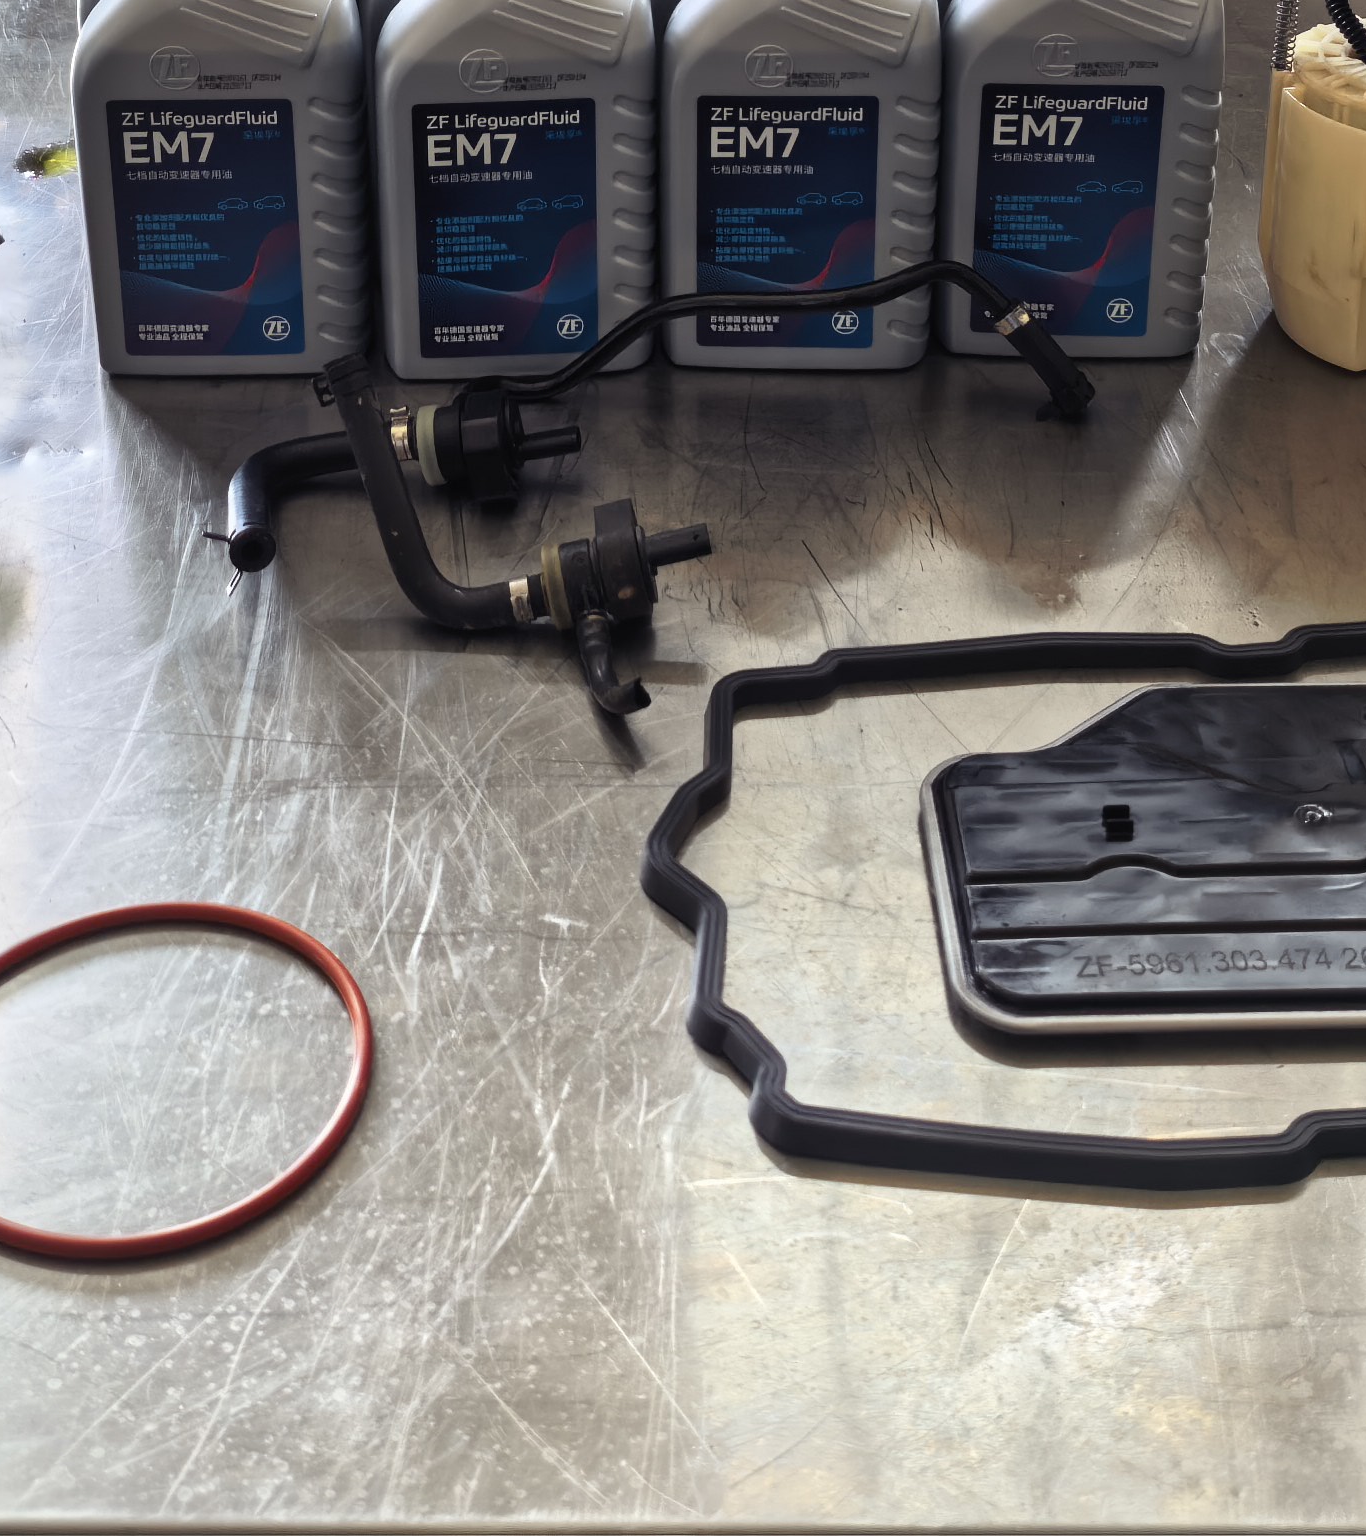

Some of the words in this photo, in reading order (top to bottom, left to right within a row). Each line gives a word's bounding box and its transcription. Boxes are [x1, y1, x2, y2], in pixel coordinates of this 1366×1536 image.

[995, 95, 1019, 110] ZF
[1022, 95, 1149, 112] LifeguardFluid
[121, 112, 145, 127] ZF
[150, 111, 278, 128] LifeguardFluid
[426, 115, 449, 130] ZF
[455, 110, 580, 131] LifeguardFluid
[710, 107, 734, 122] ZF
[738, 107, 864, 124] LifeguardFluid
[992, 114, 1083, 146] EM7
[122, 131, 215, 164] EM7
[427, 132, 518, 168] EM7
[710, 126, 801, 159] EM7
[992, 152, 1096, 163] 七档自动变速器专用油
[126, 169, 234, 182] 七档自动变速器专用油
[429, 170, 534, 184] 七档自动变速器专用油
[710, 164, 815, 175] 七档自动变速器专用油
[1108, 302, 1133, 319] ZF
[264, 319, 290, 337] ZF
[558, 318, 583, 335] ZF
[833, 313, 858, 331] ZF
